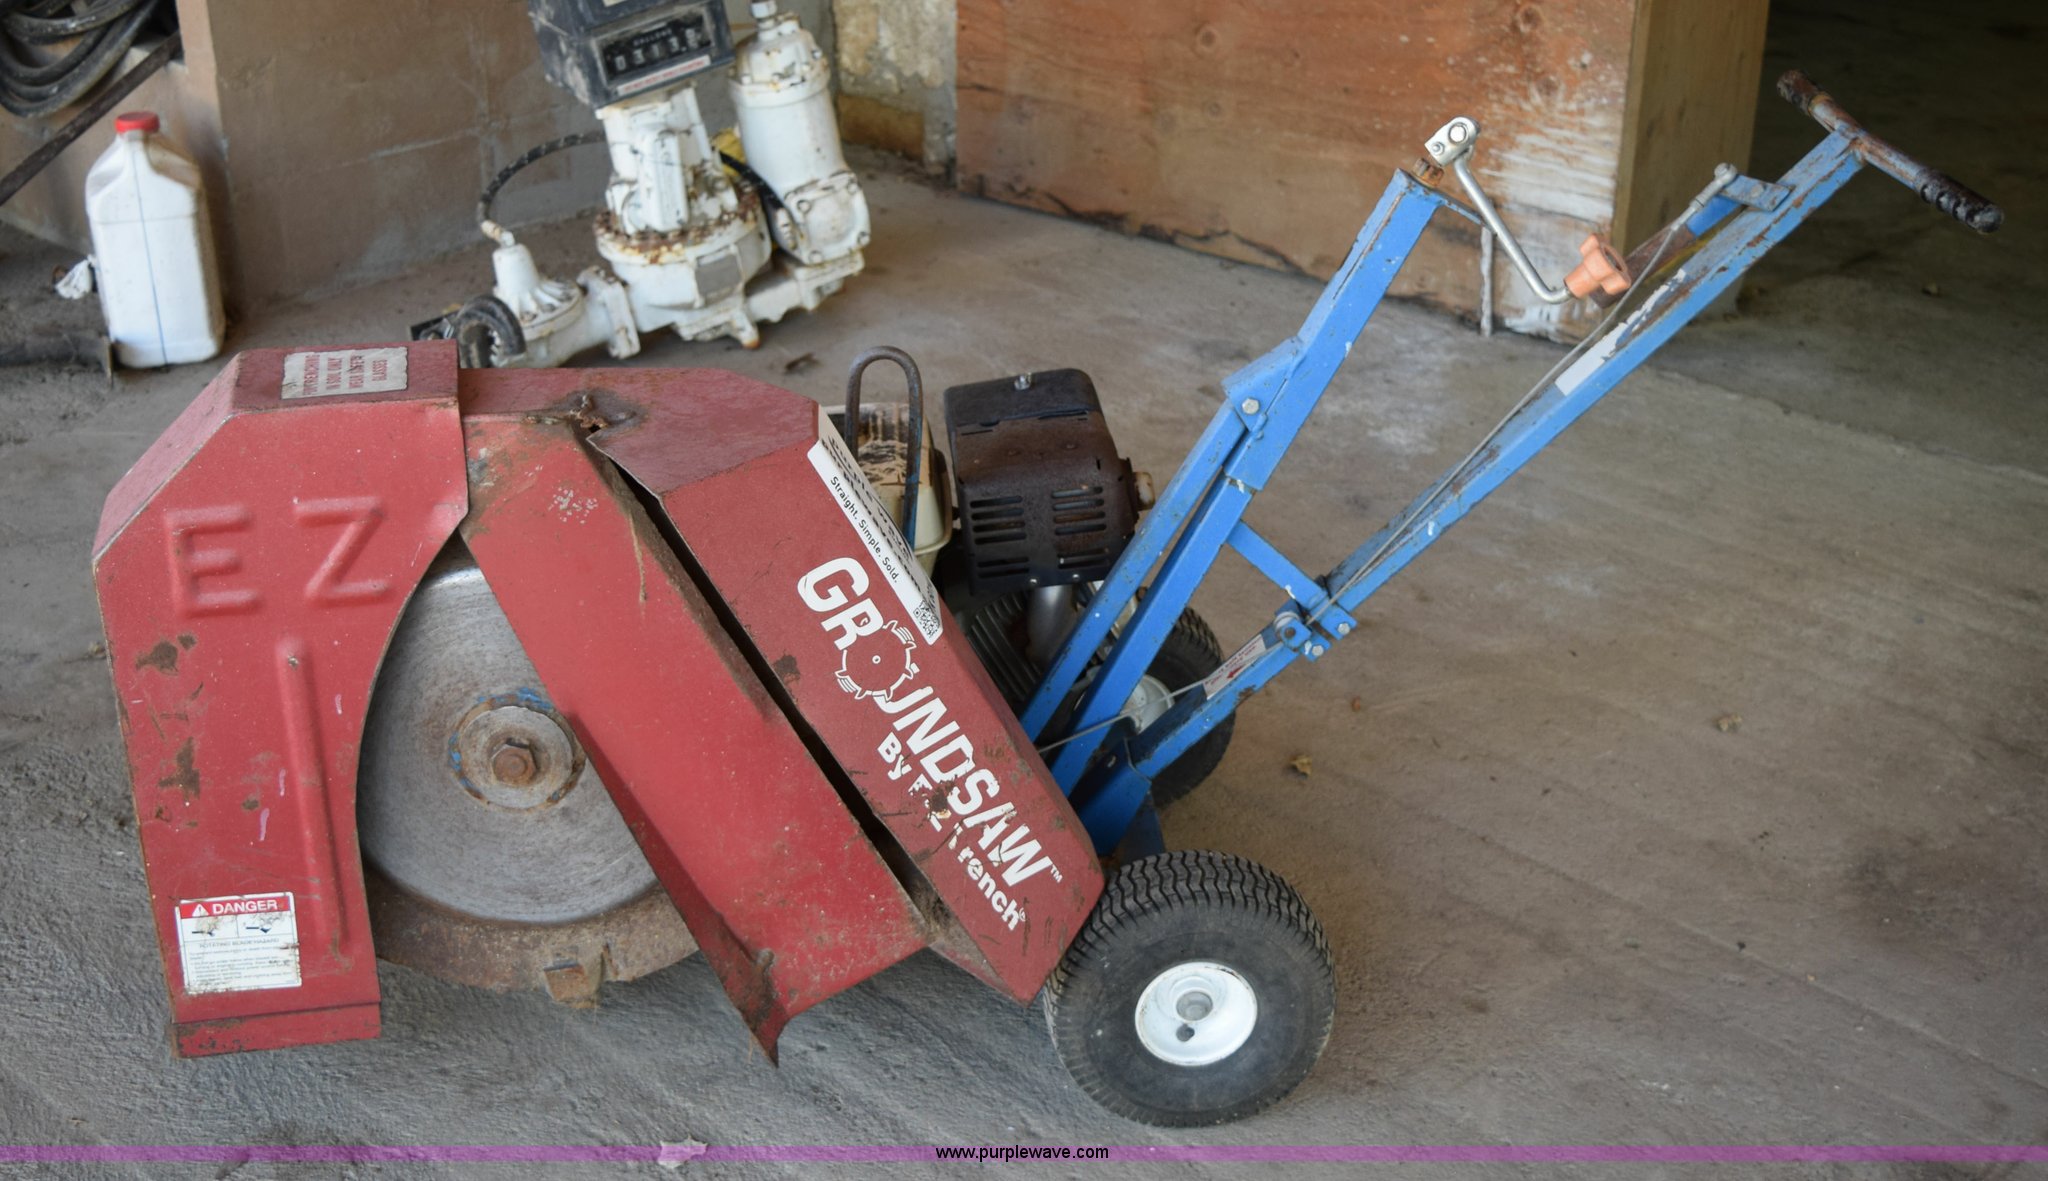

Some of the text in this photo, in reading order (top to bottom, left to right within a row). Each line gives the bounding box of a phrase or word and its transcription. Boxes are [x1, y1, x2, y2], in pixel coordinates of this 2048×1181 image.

[830, 476, 858, 520] Straight.
[858, 519, 882, 558] Simple.
[882, 556, 899, 584] Sold.
[877, 732, 912, 780] By
[212, 899, 278, 915] DANGER
